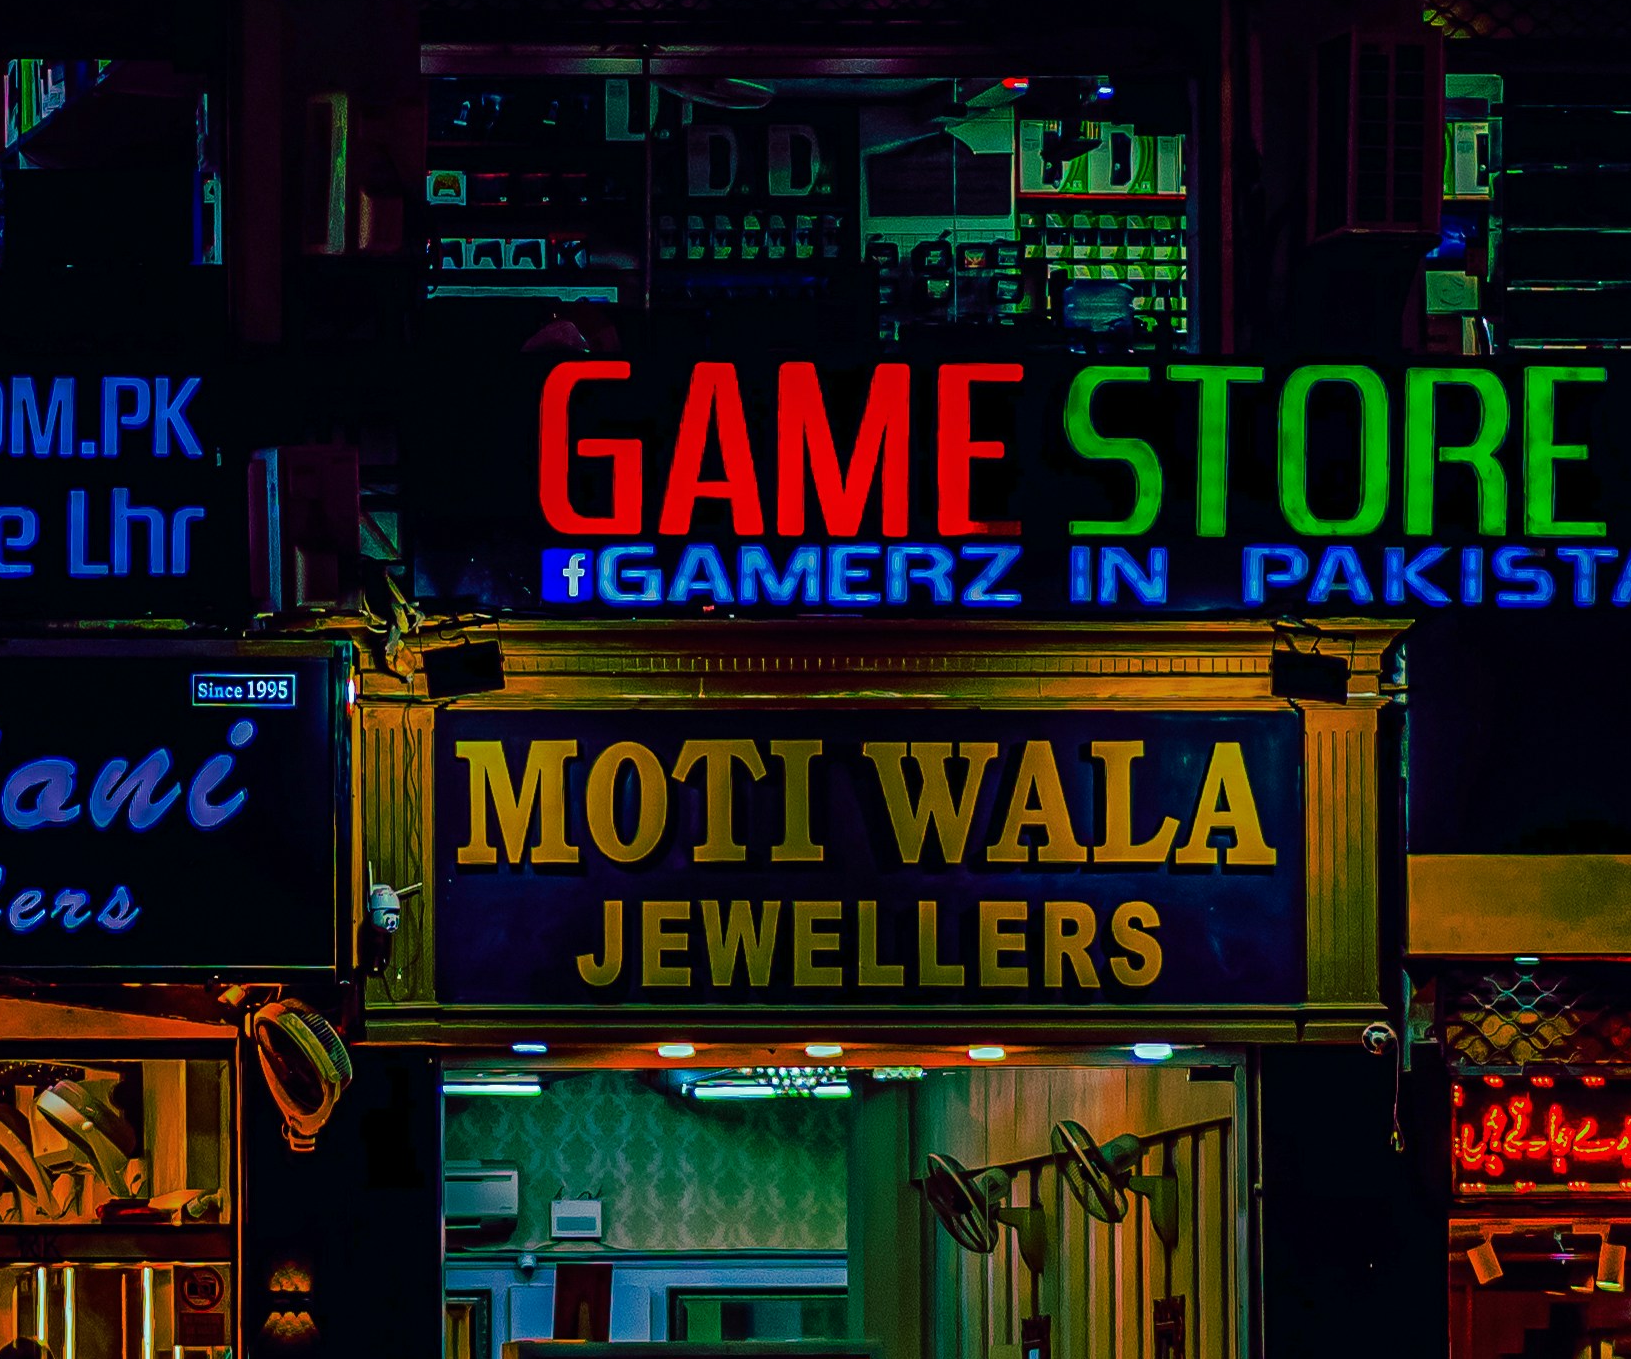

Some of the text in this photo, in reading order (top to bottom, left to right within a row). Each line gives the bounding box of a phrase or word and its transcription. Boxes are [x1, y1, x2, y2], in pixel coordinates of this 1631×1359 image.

[538, 360, 1024, 538] GAME
[67, 487, 205, 577] Lhr
[596, 543, 1023, 607] GAMERZ
[1069, 544, 1169, 607] IN
[198, 680, 288, 699] Since 1995
[454, 739, 1278, 866] MOTI WALA
[575, 899, 1164, 988] JEWELLERS
